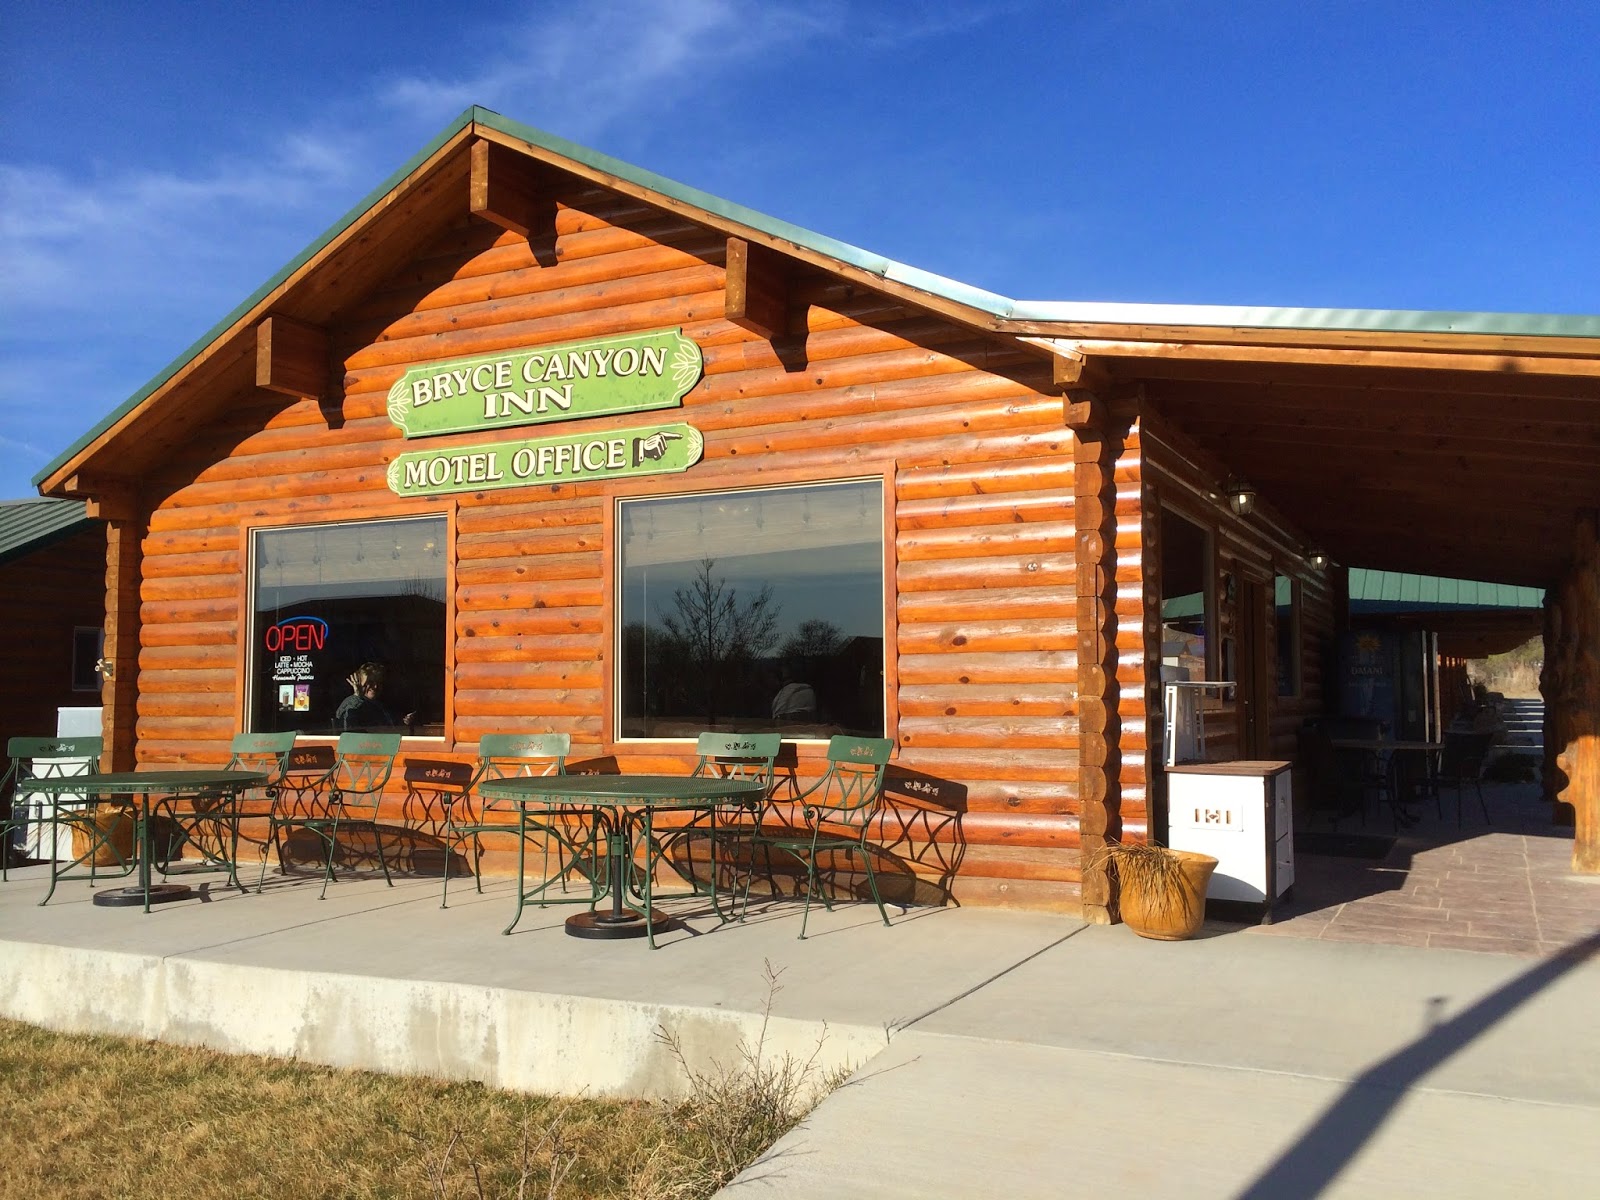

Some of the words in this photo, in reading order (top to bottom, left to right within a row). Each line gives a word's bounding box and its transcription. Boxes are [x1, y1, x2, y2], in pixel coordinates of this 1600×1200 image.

[411, 361, 513, 407] BRYCE
[522, 347, 668, 382] CANYON
[484, 383, 575, 419] INN
[403, 452, 504, 489] MOTEL
[512, 438, 627, 479] OFFICE
[265, 624, 325, 652] OPEN
[274, 661, 290, 669] LATTE
[276, 667, 311, 675] CAPPUCCINO
[296, 654, 308, 662] HOT
